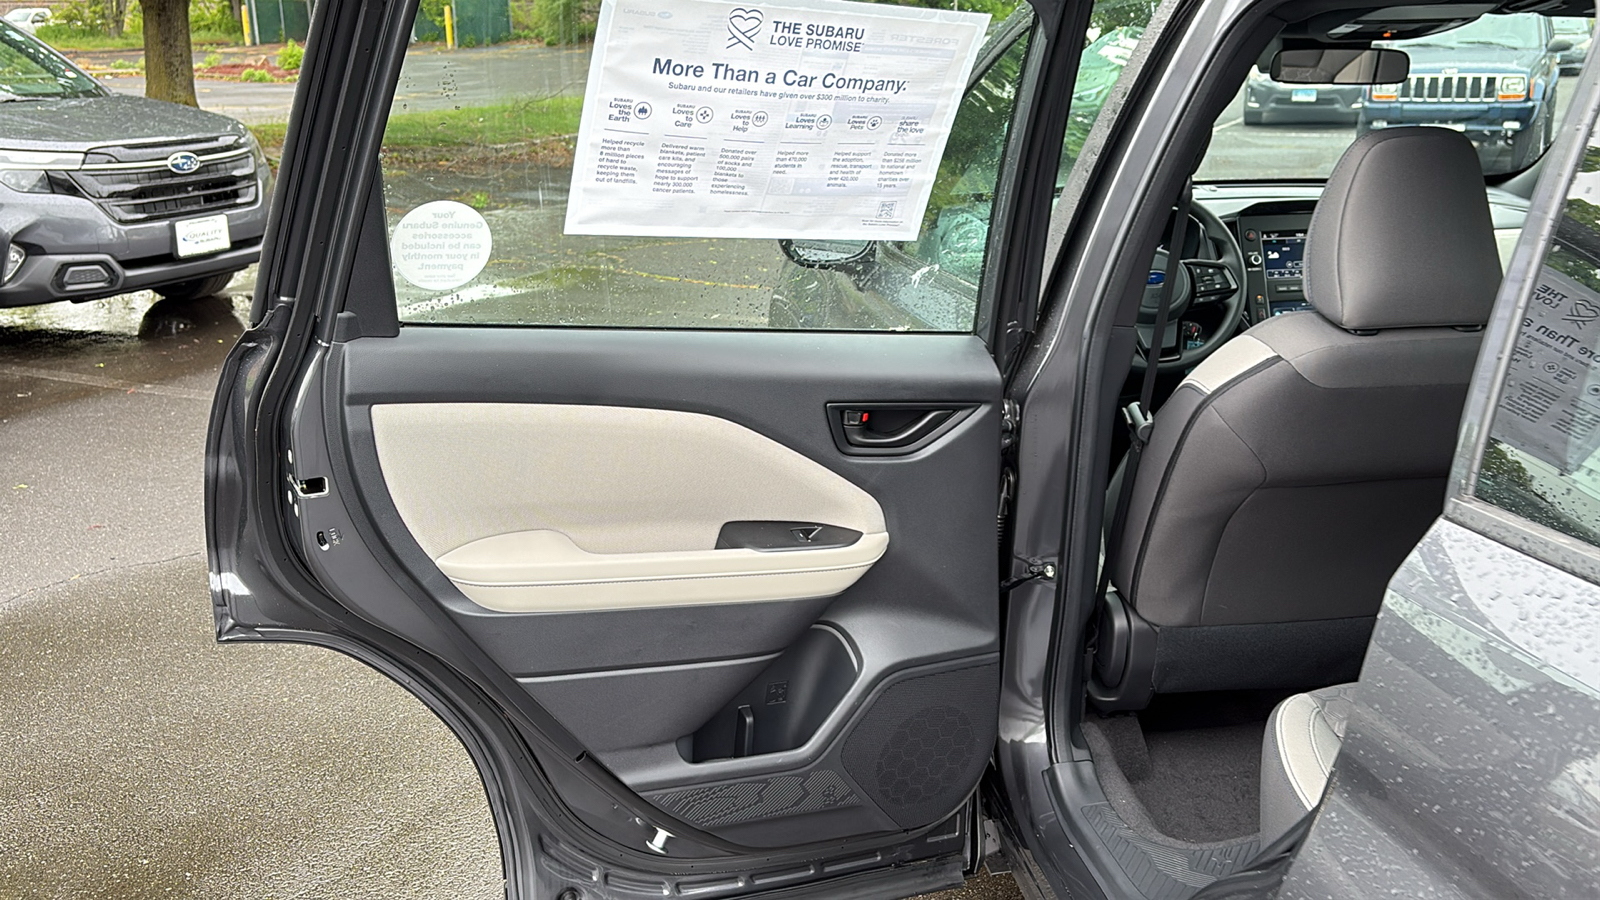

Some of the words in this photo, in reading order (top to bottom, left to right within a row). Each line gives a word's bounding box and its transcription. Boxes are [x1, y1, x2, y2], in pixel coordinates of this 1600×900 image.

[772, 21, 802, 35] THE
[805, 23, 864, 40] SUBARU
[769, 35, 802, 48] LOVE
[805, 38, 861, 52] PROMISE
[652, 57, 704, 78] More
[711, 62, 759, 82] Than
[765, 71, 776, 84] a
[783, 70, 818, 88] Car
[668, 82, 697, 91] Subaru
[697, 84, 712, 92] and
[728, 87, 759, 97] retailers
[759, 90, 777, 98] have
[778, 91, 799, 100] given
[816, 93, 833, 101] $300
[833, 94, 857, 102] million
[865, 96, 890, 104] charity.
[609, 102, 632, 110] Loves
[672, 107, 694, 116] Loves
[608, 114, 630, 122] Earth
[796, 116, 816, 124] Loves
[674, 120, 692, 128] Care
[785, 122, 814, 130] Learning
[732, 125, 749, 133] Help
[602, 138, 623, 146] Helped
[661, 142, 688, 150] Delivered
[655, 174, 669, 182] hope
[189, 229, 222, 239] QUALITY
